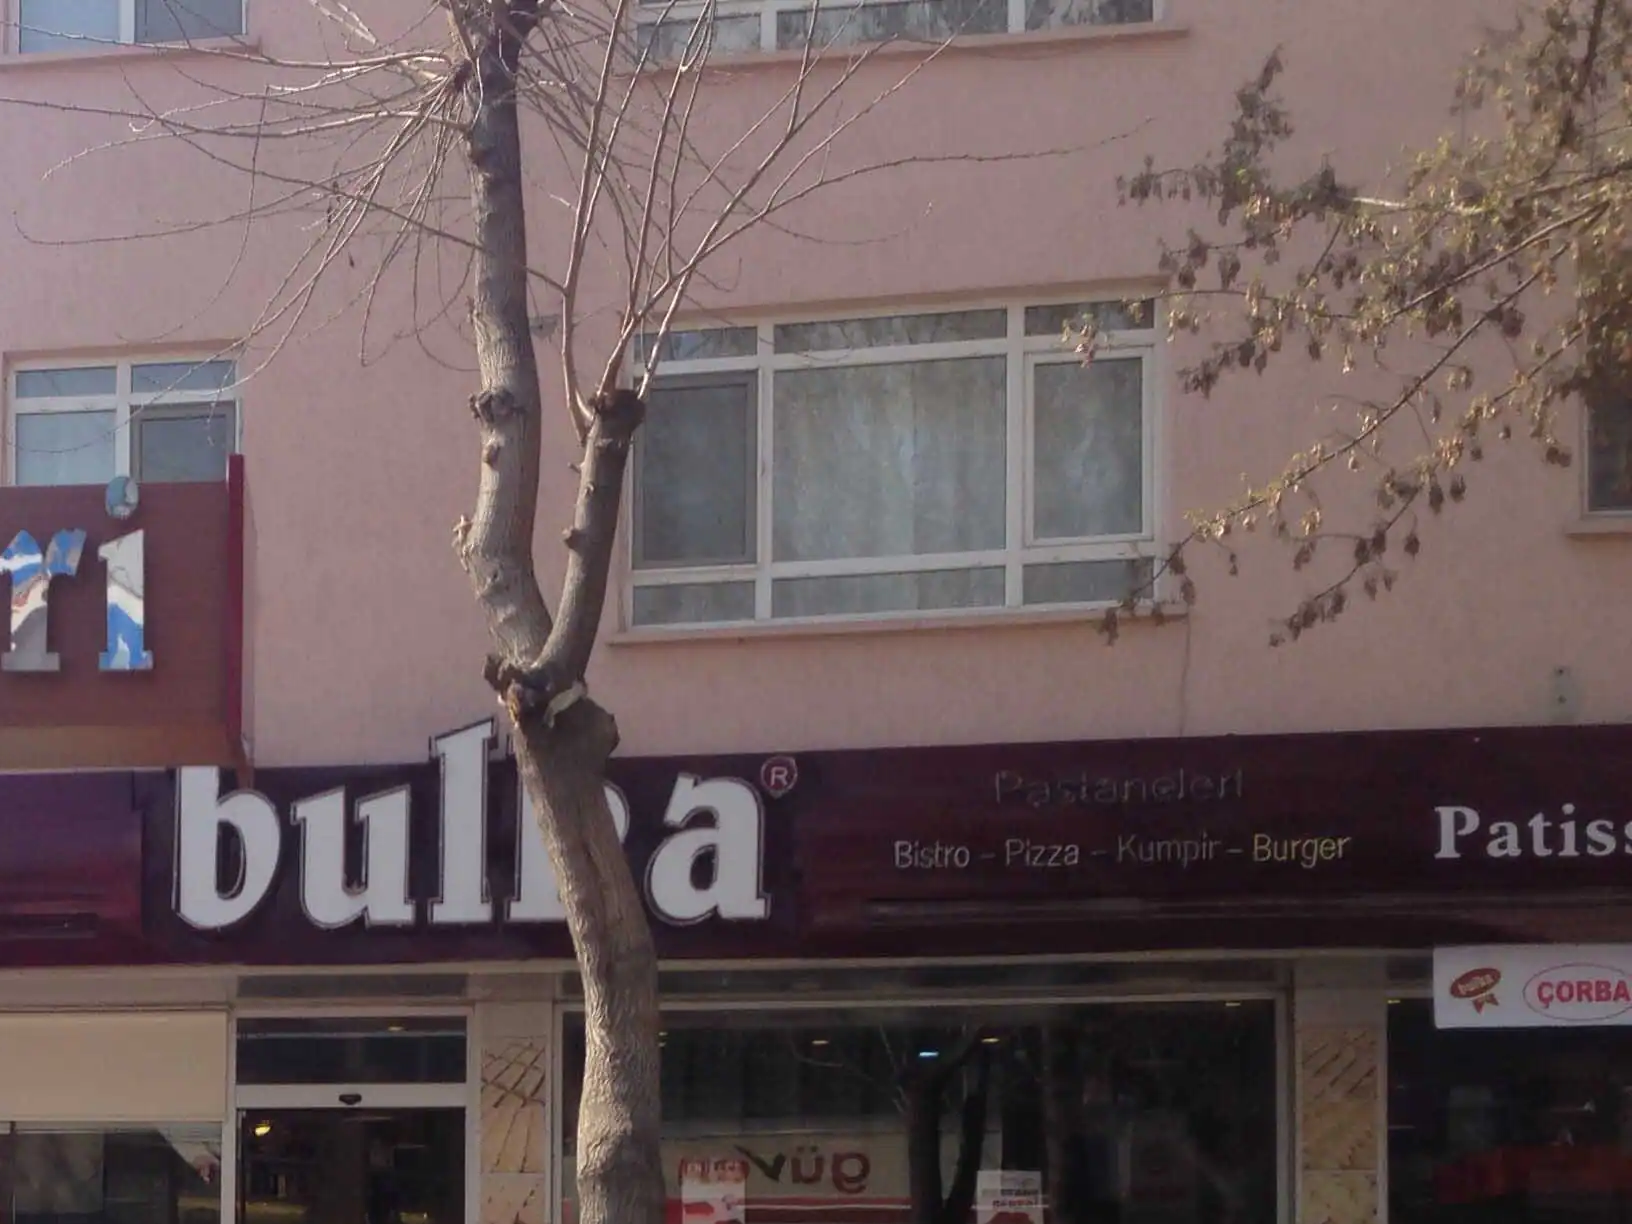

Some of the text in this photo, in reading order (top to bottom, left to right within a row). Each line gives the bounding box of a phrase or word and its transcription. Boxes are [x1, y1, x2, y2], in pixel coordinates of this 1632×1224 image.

[892, 839, 970, 869] Bistro
[1004, 838, 1080, 868] Pizza
[1116, 831, 1222, 868] Kumpir
[1252, 833, 1352, 869] Burger
[1433, 803, 1632, 859] Patis
